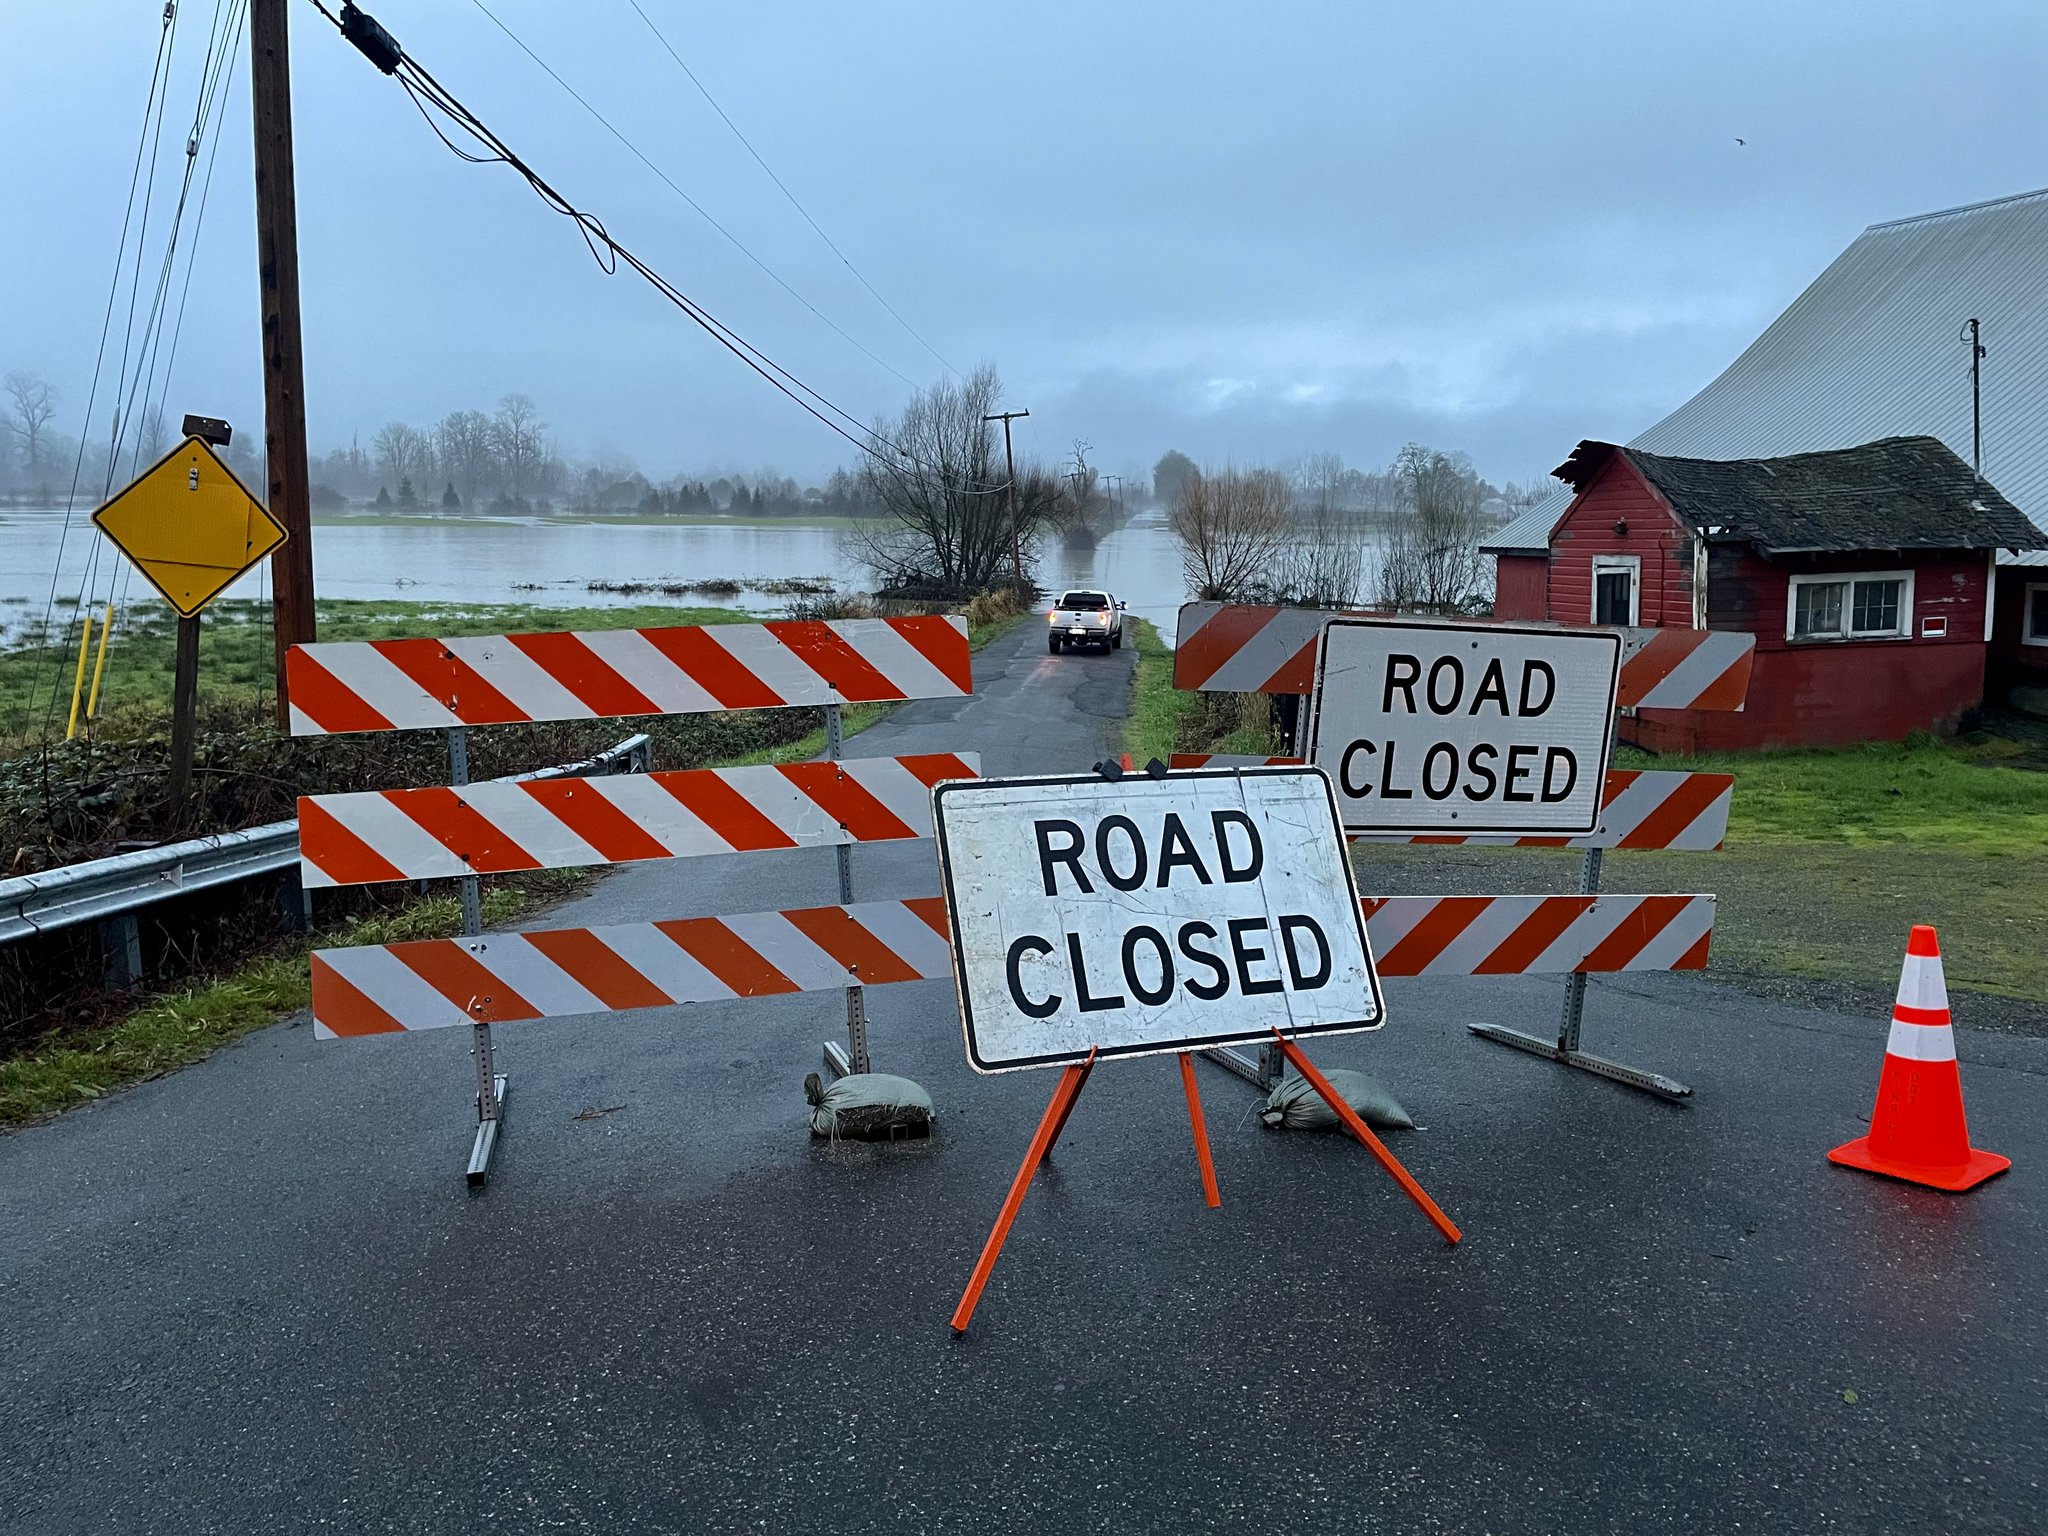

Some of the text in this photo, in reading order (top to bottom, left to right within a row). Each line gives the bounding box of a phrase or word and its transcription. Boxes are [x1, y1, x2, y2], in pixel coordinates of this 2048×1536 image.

[1382, 653, 1556, 717] ROAD
[1339, 738, 1578, 802] CLOSED
[1034, 810, 1263, 896] ROAD
[1006, 914, 1332, 1018] CLOSED
